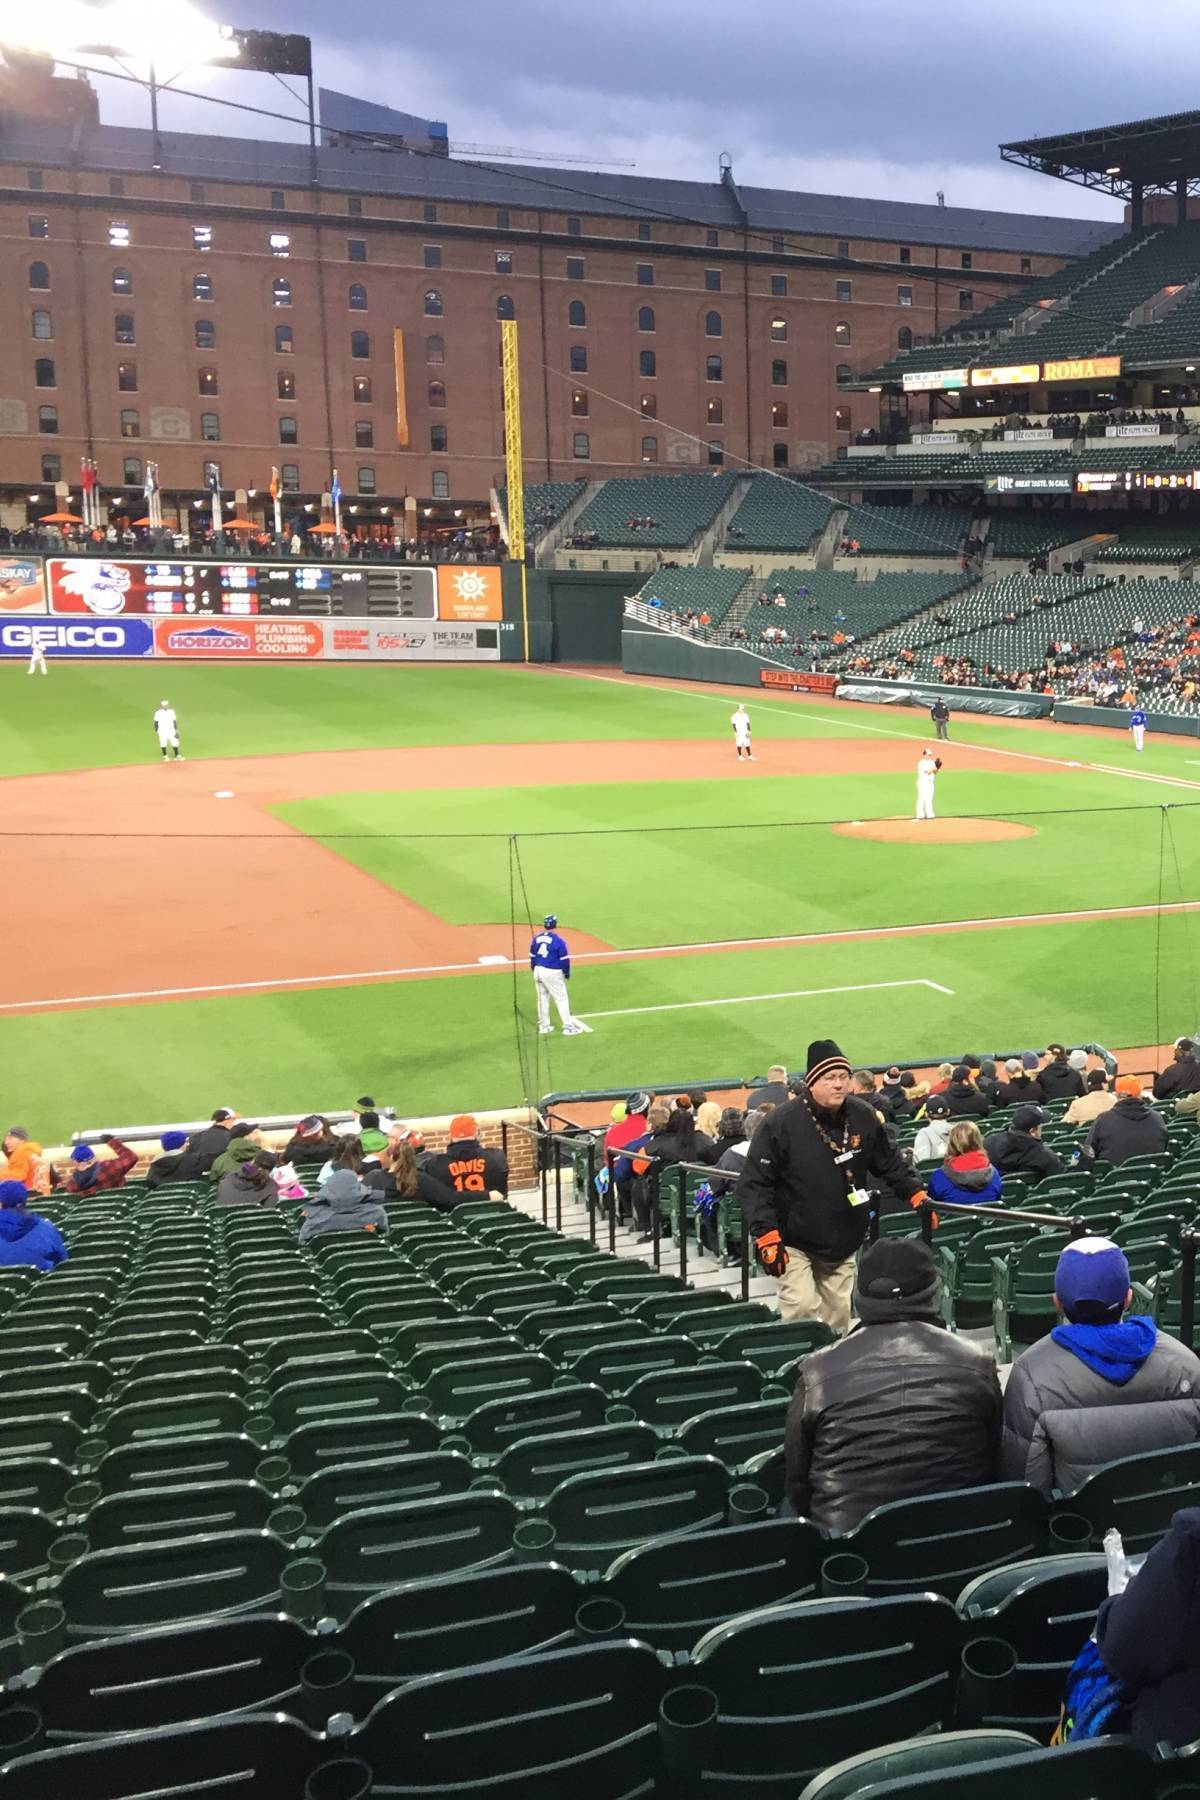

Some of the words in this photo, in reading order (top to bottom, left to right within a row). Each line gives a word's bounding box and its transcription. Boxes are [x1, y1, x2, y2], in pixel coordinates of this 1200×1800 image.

[1045, 361, 1096, 382] ROMA
[997, 476, 1014, 492] Lite
[254, 623, 306, 635] HEATING
[500, 623, 515, 632] 318
[2, 625, 125, 648] GEICO
[169, 635, 250, 649] HORIZON
[254, 634, 316, 645] PLUMBING
[432, 632, 449, 641] THE
[450, 632, 474, 641] TEAM
[254, 644, 308, 654] COOLING
[537, 943, 549, 958] 4
[448, 1158, 486, 1177] DAVIS
